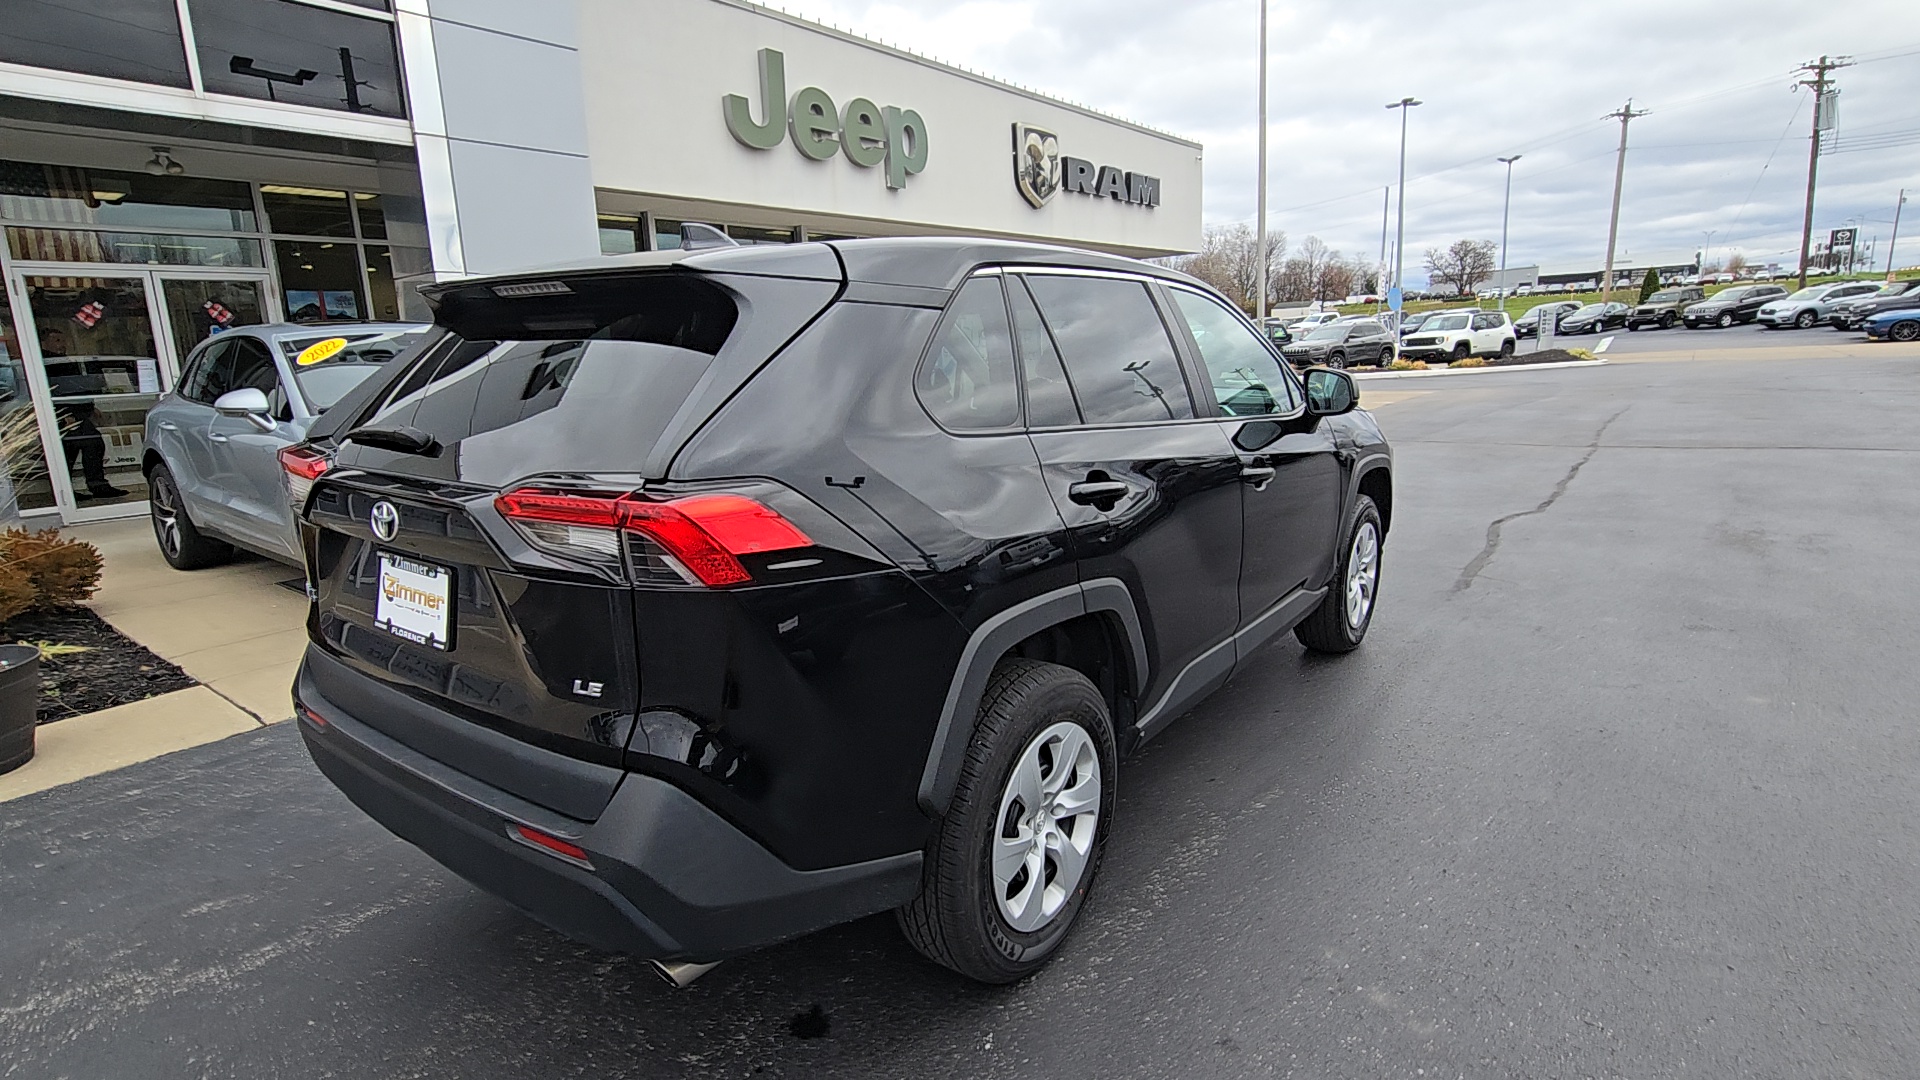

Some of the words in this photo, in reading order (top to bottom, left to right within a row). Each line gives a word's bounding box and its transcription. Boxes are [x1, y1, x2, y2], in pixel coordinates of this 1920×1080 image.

[722, 47, 929, 191] Jeep
[1061, 156, 1161, 208] RAM
[306, 341, 340, 361] 2022
[394, 555, 428, 576] Zimmer
[385, 575, 445, 611] Zimmer
[391, 626, 426, 645] FLORENCE
[573, 679, 605, 698] LE
